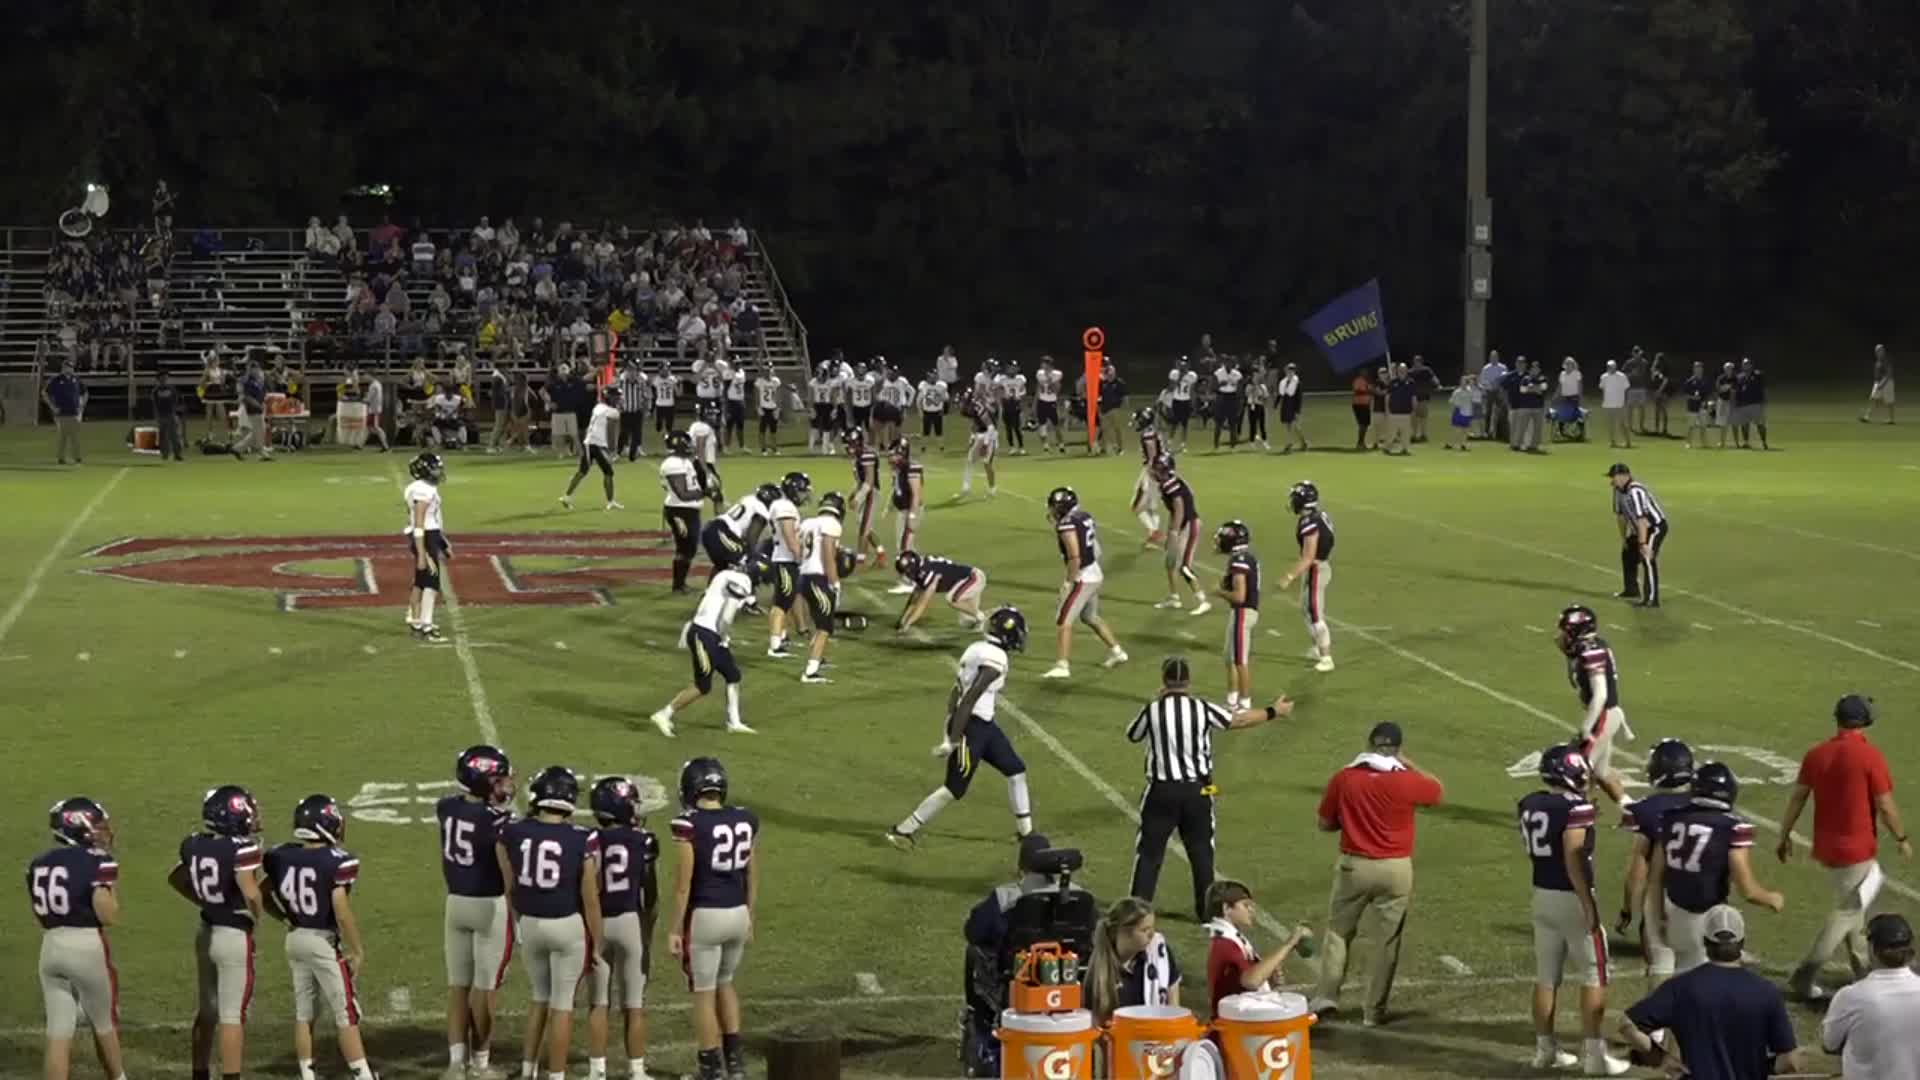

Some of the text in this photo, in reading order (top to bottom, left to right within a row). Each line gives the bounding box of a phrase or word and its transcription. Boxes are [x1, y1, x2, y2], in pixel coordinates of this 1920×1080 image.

[444, 815, 476, 866] 15
[518, 838, 562, 888] 16
[711, 823, 753, 871] 22
[1666, 822, 1713, 873] 27
[32, 866, 70, 916] 56
[280, 866, 319, 916] 46
[1046, 990, 1062, 1007] G
[1043, 1049, 1071, 1080] G
[1262, 1037, 1290, 1069] G
